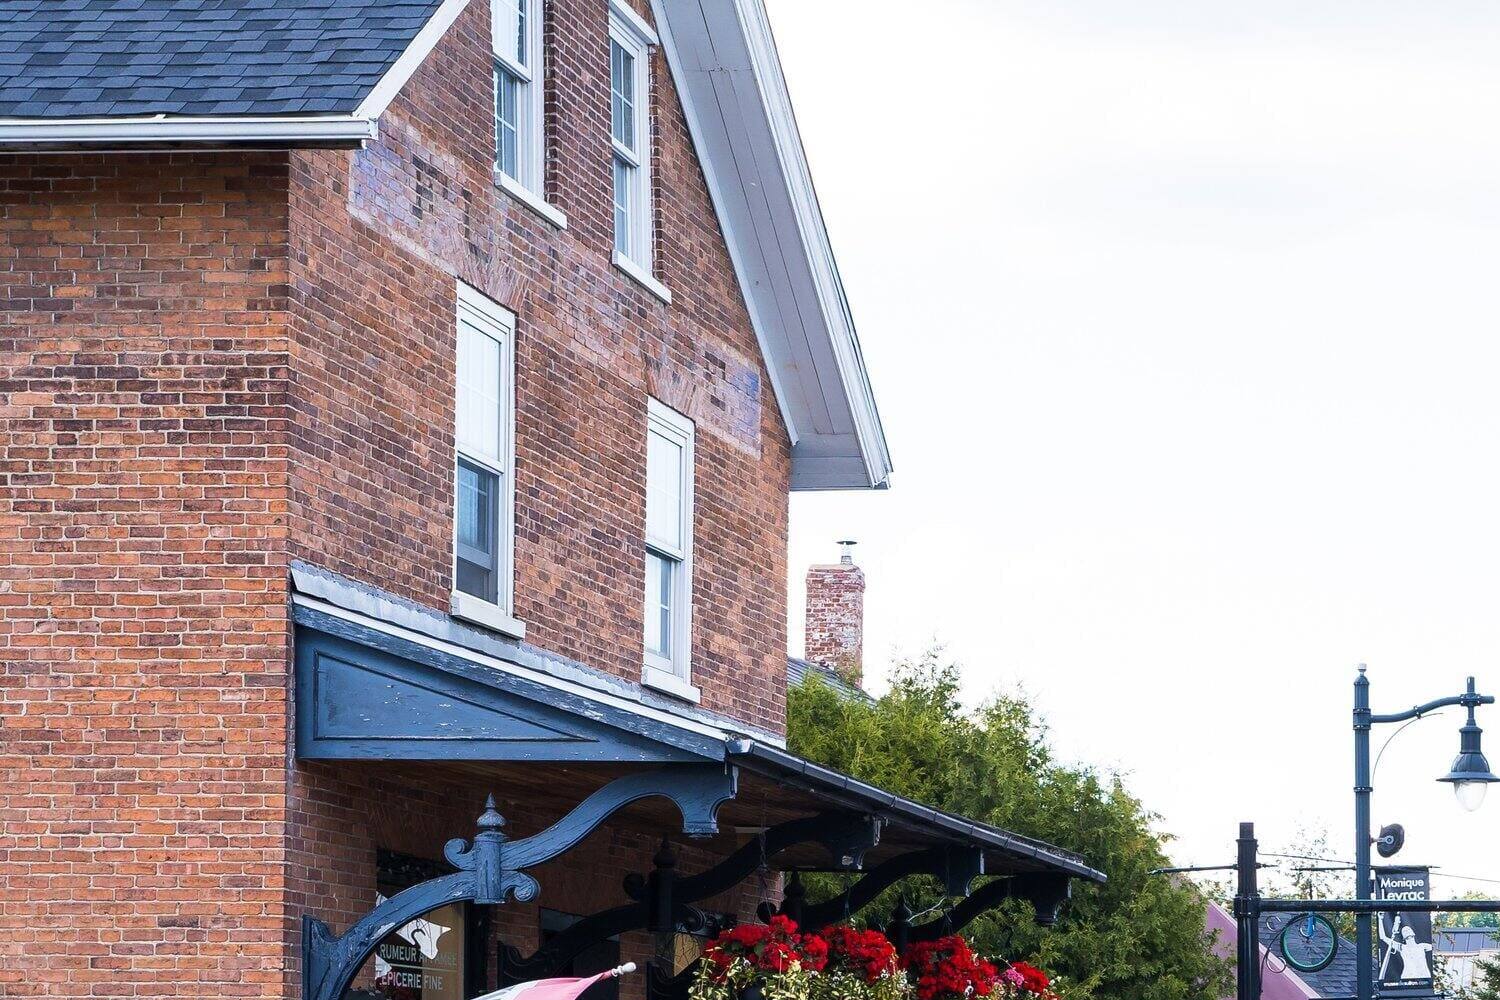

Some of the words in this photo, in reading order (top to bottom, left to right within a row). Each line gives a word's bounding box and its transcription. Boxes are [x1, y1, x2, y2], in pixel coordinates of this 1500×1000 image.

[1381, 878, 1424, 890] Monique
[380, 944, 417, 962] RUMEUR
[423, 976, 443, 990] FINE
